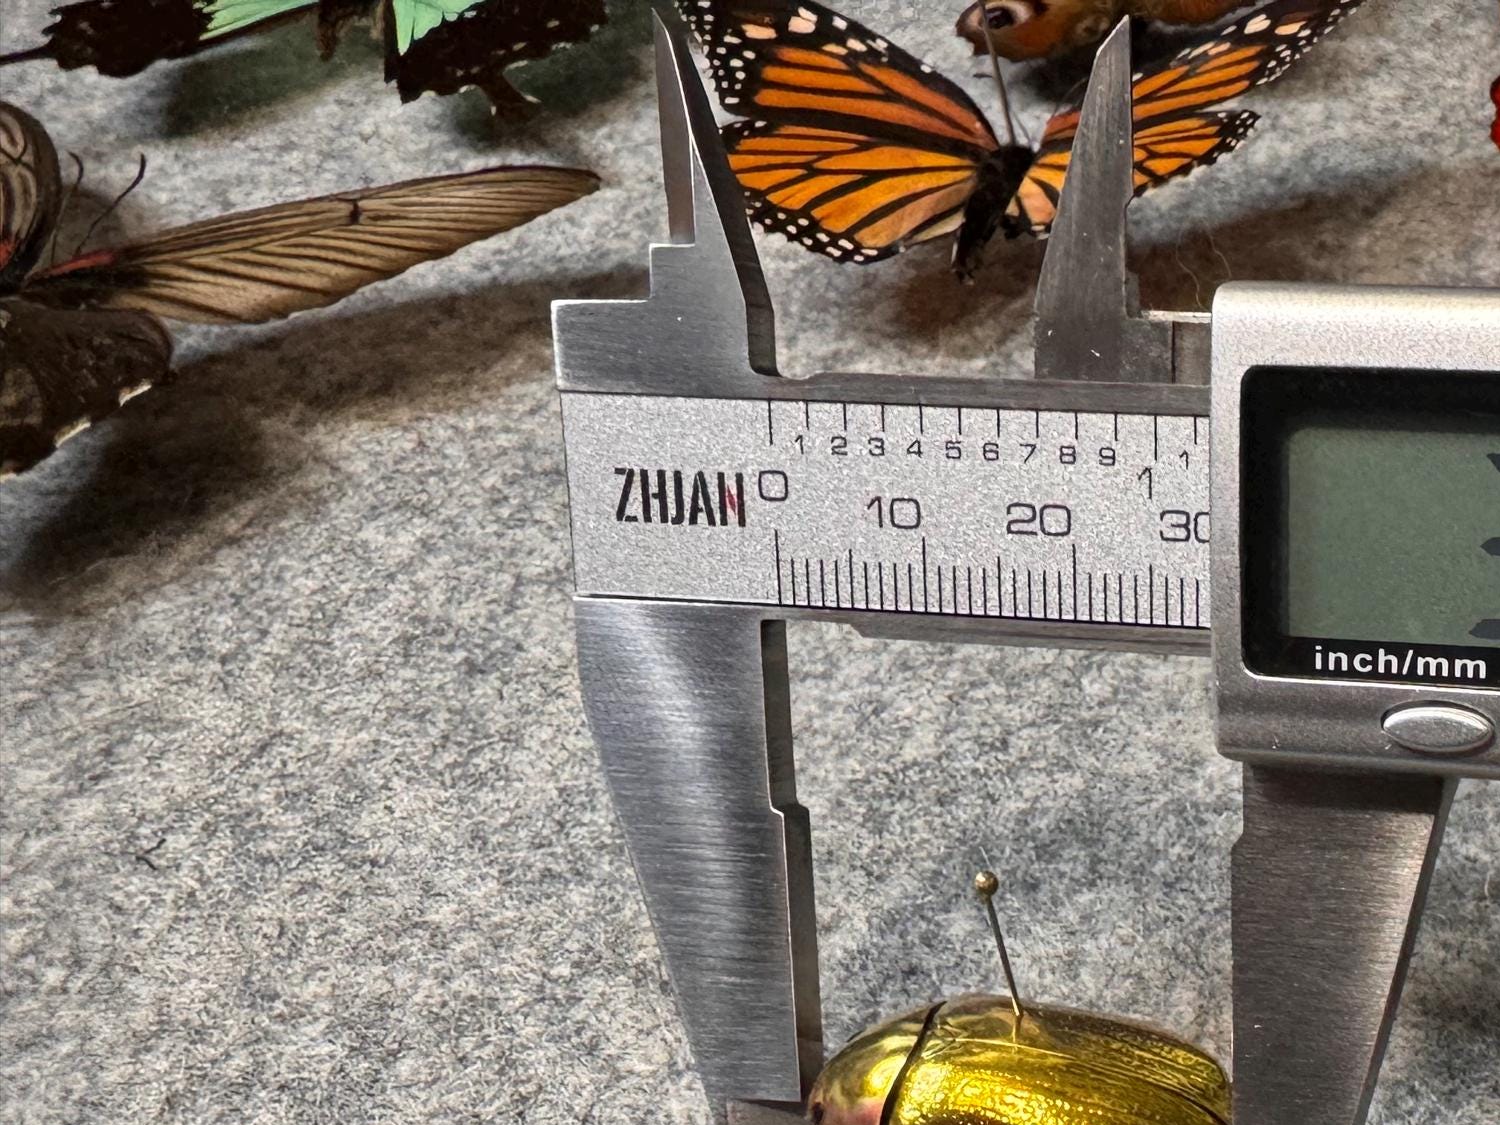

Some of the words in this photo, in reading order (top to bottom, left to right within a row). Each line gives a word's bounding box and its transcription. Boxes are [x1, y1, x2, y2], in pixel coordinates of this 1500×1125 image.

[795, 434, 806, 455] 1
[830, 436, 848, 456] 2
[868, 437, 886, 457] 3
[906, 439, 922, 459] 4
[945, 440, 962, 460] 5
[983, 442, 999, 461] 6
[1019, 443, 1037, 464] 7
[1059, 445, 1077, 465] 8
[1099, 447, 1116, 467] 9
[1179, 450, 1189, 471] 1
[1137, 466, 1153, 500] 1
[866, 495, 922, 530] 10
[1006, 501, 1072, 537] 20
[1313, 645, 1488, 681] inch/mm
